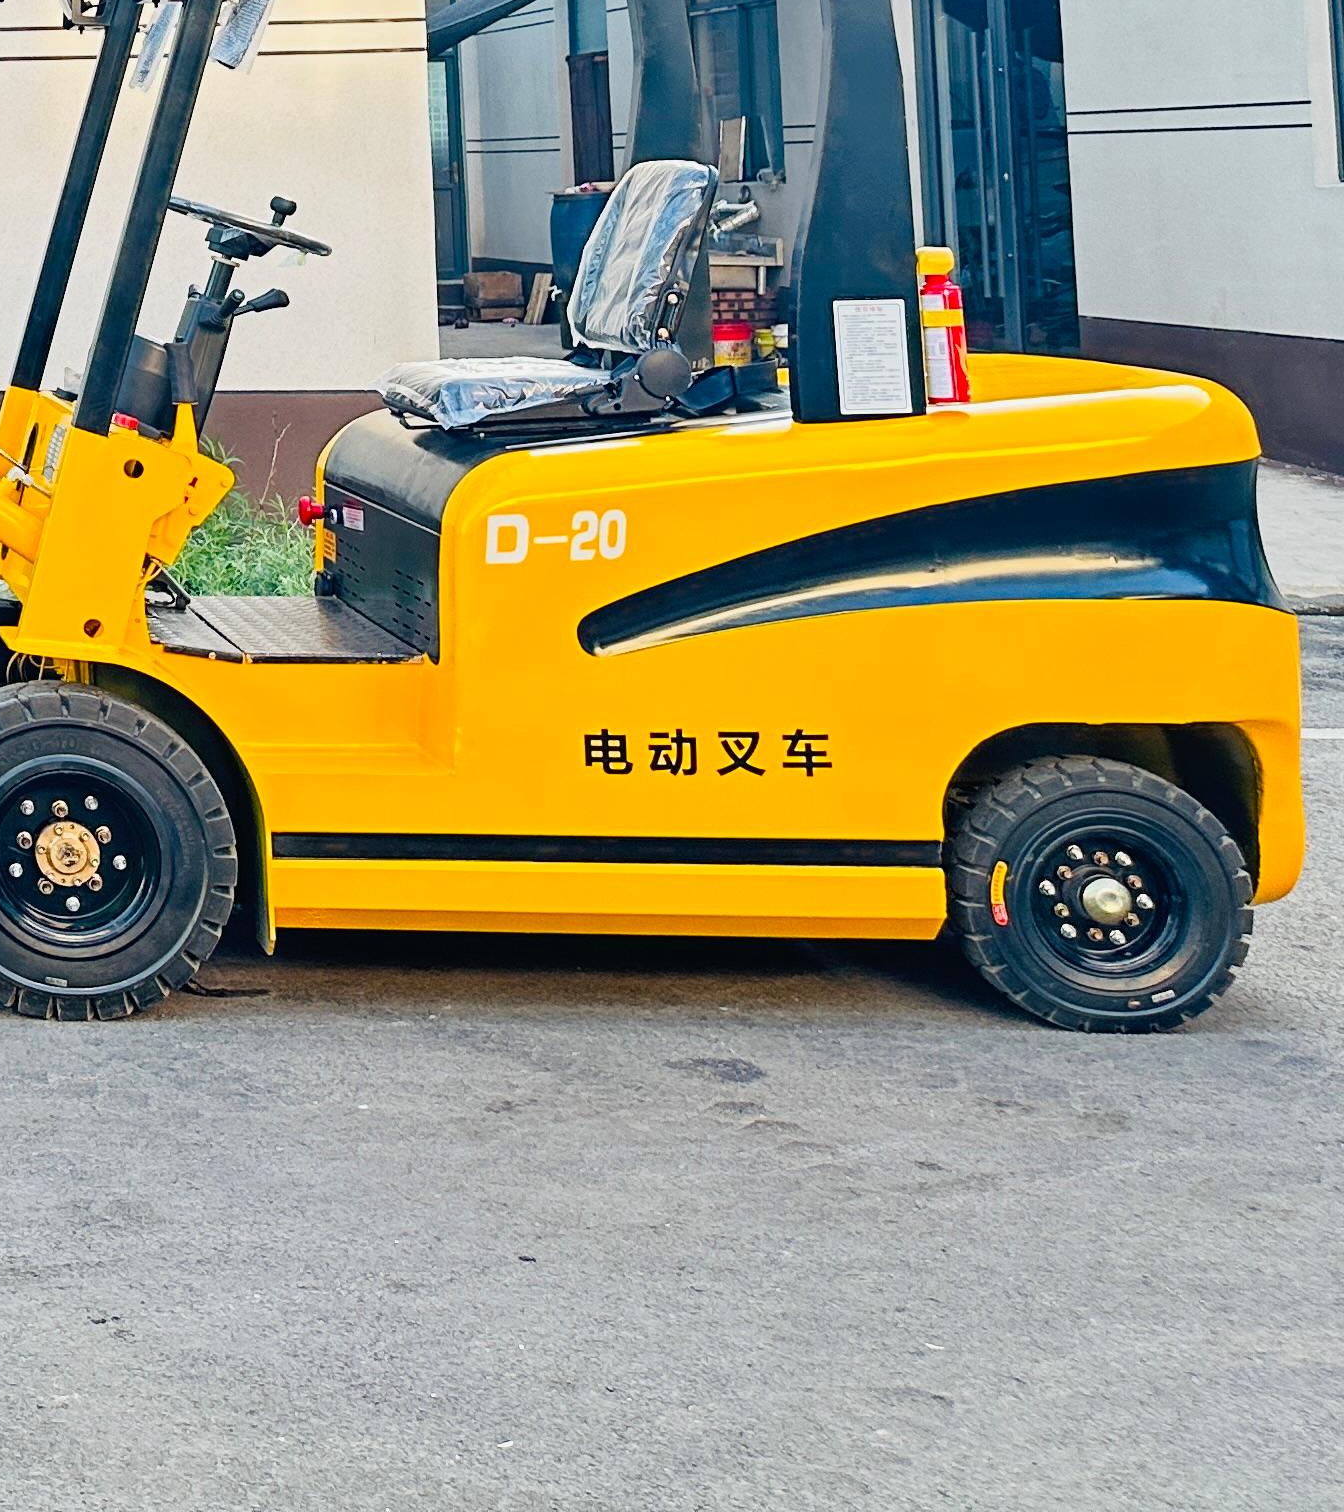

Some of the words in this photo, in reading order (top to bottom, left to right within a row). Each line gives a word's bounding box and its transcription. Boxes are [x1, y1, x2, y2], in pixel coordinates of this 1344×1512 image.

[485, 509, 627, 565] D-20
[583, 728, 833, 777] 电动叉车
